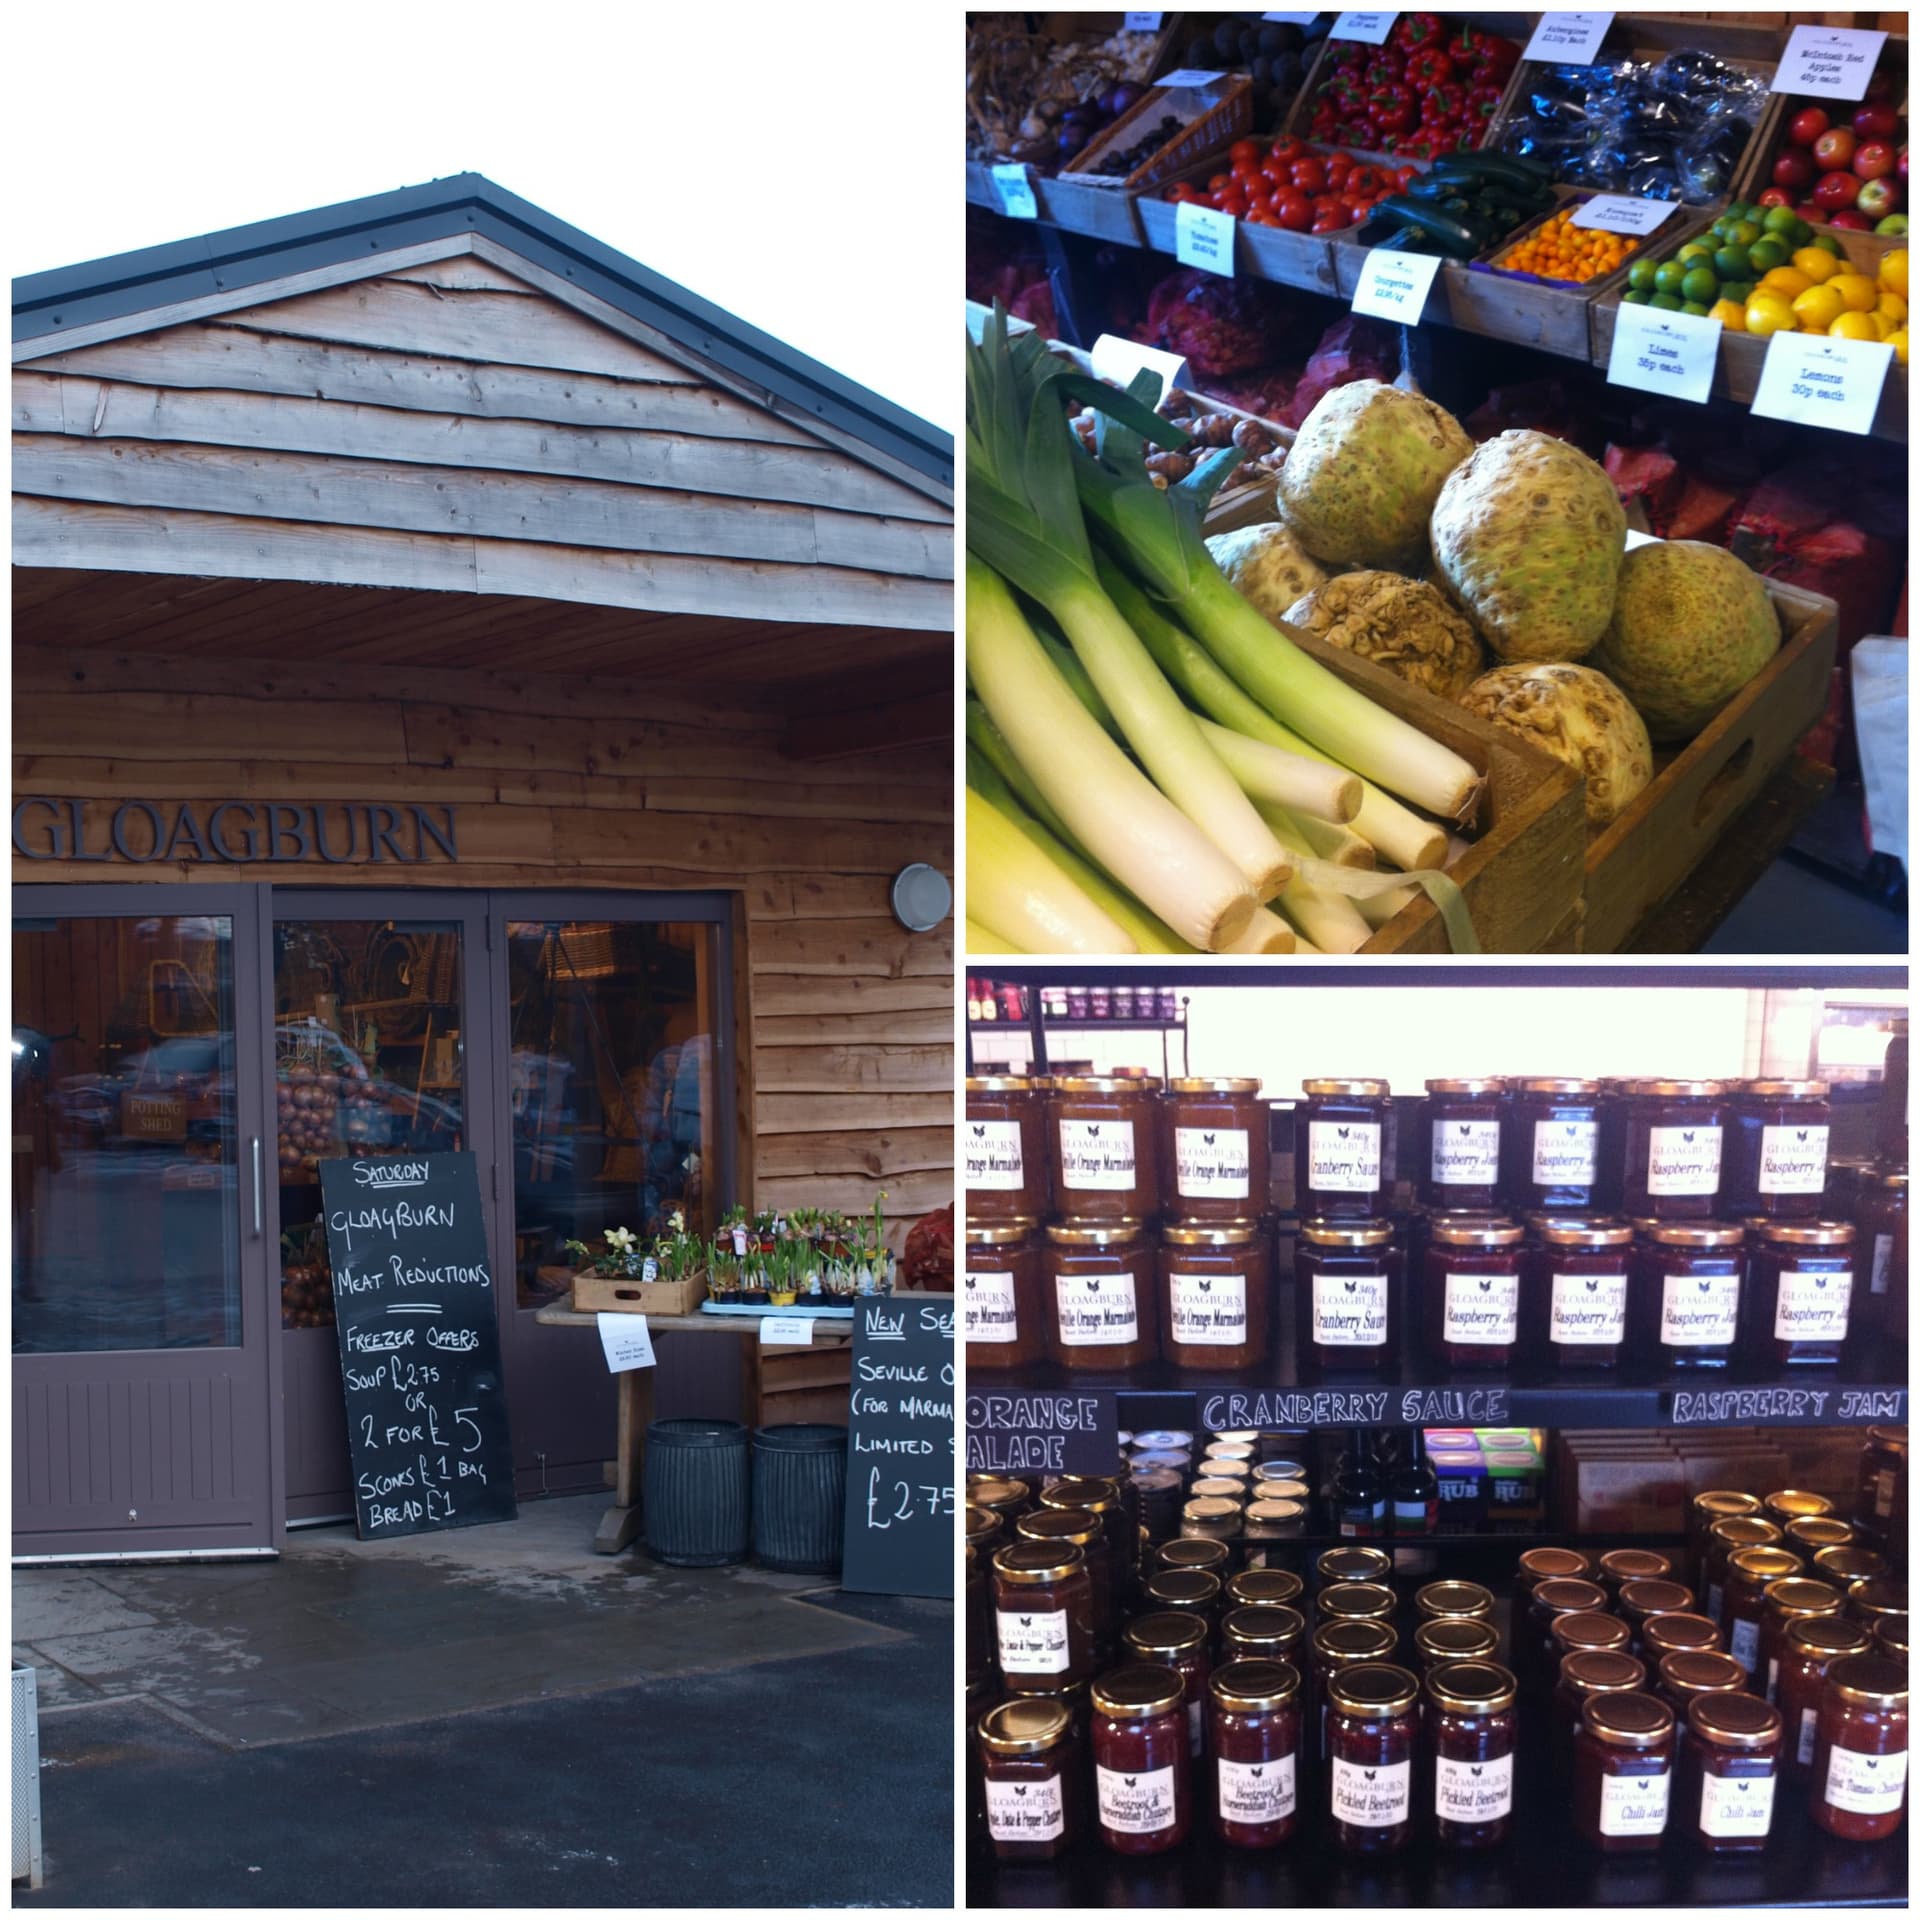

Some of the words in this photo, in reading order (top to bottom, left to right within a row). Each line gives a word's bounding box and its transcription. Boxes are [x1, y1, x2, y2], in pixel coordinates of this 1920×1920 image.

[1808, 62, 1842, 72] Apples
[1819, 76, 1842, 84] each
[1648, 344, 1679, 359] Limes
[1659, 363, 1685, 375] each
[1800, 368, 1844, 385] Lemons
[1817, 389, 1845, 401] each
[12, 797, 459, 864] GLOAGBURN
[130, 1100, 181, 1114] POTTING
[1077, 1152, 1101, 1176] Orange
[1434, 1151, 1480, 1169] Raspberry
[1535, 1151, 1585, 1170] Raspberry
[1651, 1158, 1704, 1178] Raspberry
[1764, 1157, 1815, 1177] Raspberry
[352, 1161, 430, 1184] SATURDAY
[1192, 1160, 1215, 1184] Orange
[330, 1201, 455, 1252] GLOAGBURN
[337, 1267, 383, 1297] MEAT
[388, 1255, 490, 1287] REDUCTIONS
[865, 1306, 905, 1332] NEW
[1076, 1309, 1101, 1331] Orange
[1187, 1308, 1212, 1332] Orange
[1314, 1308, 1361, 1334] Cranberry
[1446, 1306, 1501, 1327] Raspberry
[1553, 1306, 1607, 1328] Raspberry
[1664, 1307, 1720, 1328] Raspberry
[1780, 1303, 1835, 1325] Raspberry
[347, 1326, 416, 1351] FREEZER
[426, 1326, 480, 1349] OFFERS
[346, 1365, 387, 1391] SOUP
[857, 1356, 928, 1382] SEVILLE
[405, 1391, 428, 1413] OR
[966, 1396, 1098, 1431] ORANGE
[1203, 1392, 1389, 1431] CRANBERRY
[1401, 1389, 1509, 1422] SAUCE
[1672, 1388, 1829, 1424] RASPBERRY
[1838, 1391, 1901, 1418] JAM
[360, 1414, 379, 1449] 2
[386, 1426, 424, 1446] FOR
[855, 1431, 934, 1454] LIMITED
[966, 1435, 1065, 1470] ALADE
[358, 1466, 416, 1500] SCONES
[457, 1460, 488, 1486] BAG
[1438, 1483, 1480, 1501] RUB
[369, 1499, 423, 1529] BREAD
[1335, 1787, 1367, 1811] Pickled
[1440, 1785, 1473, 1807] Pickled
